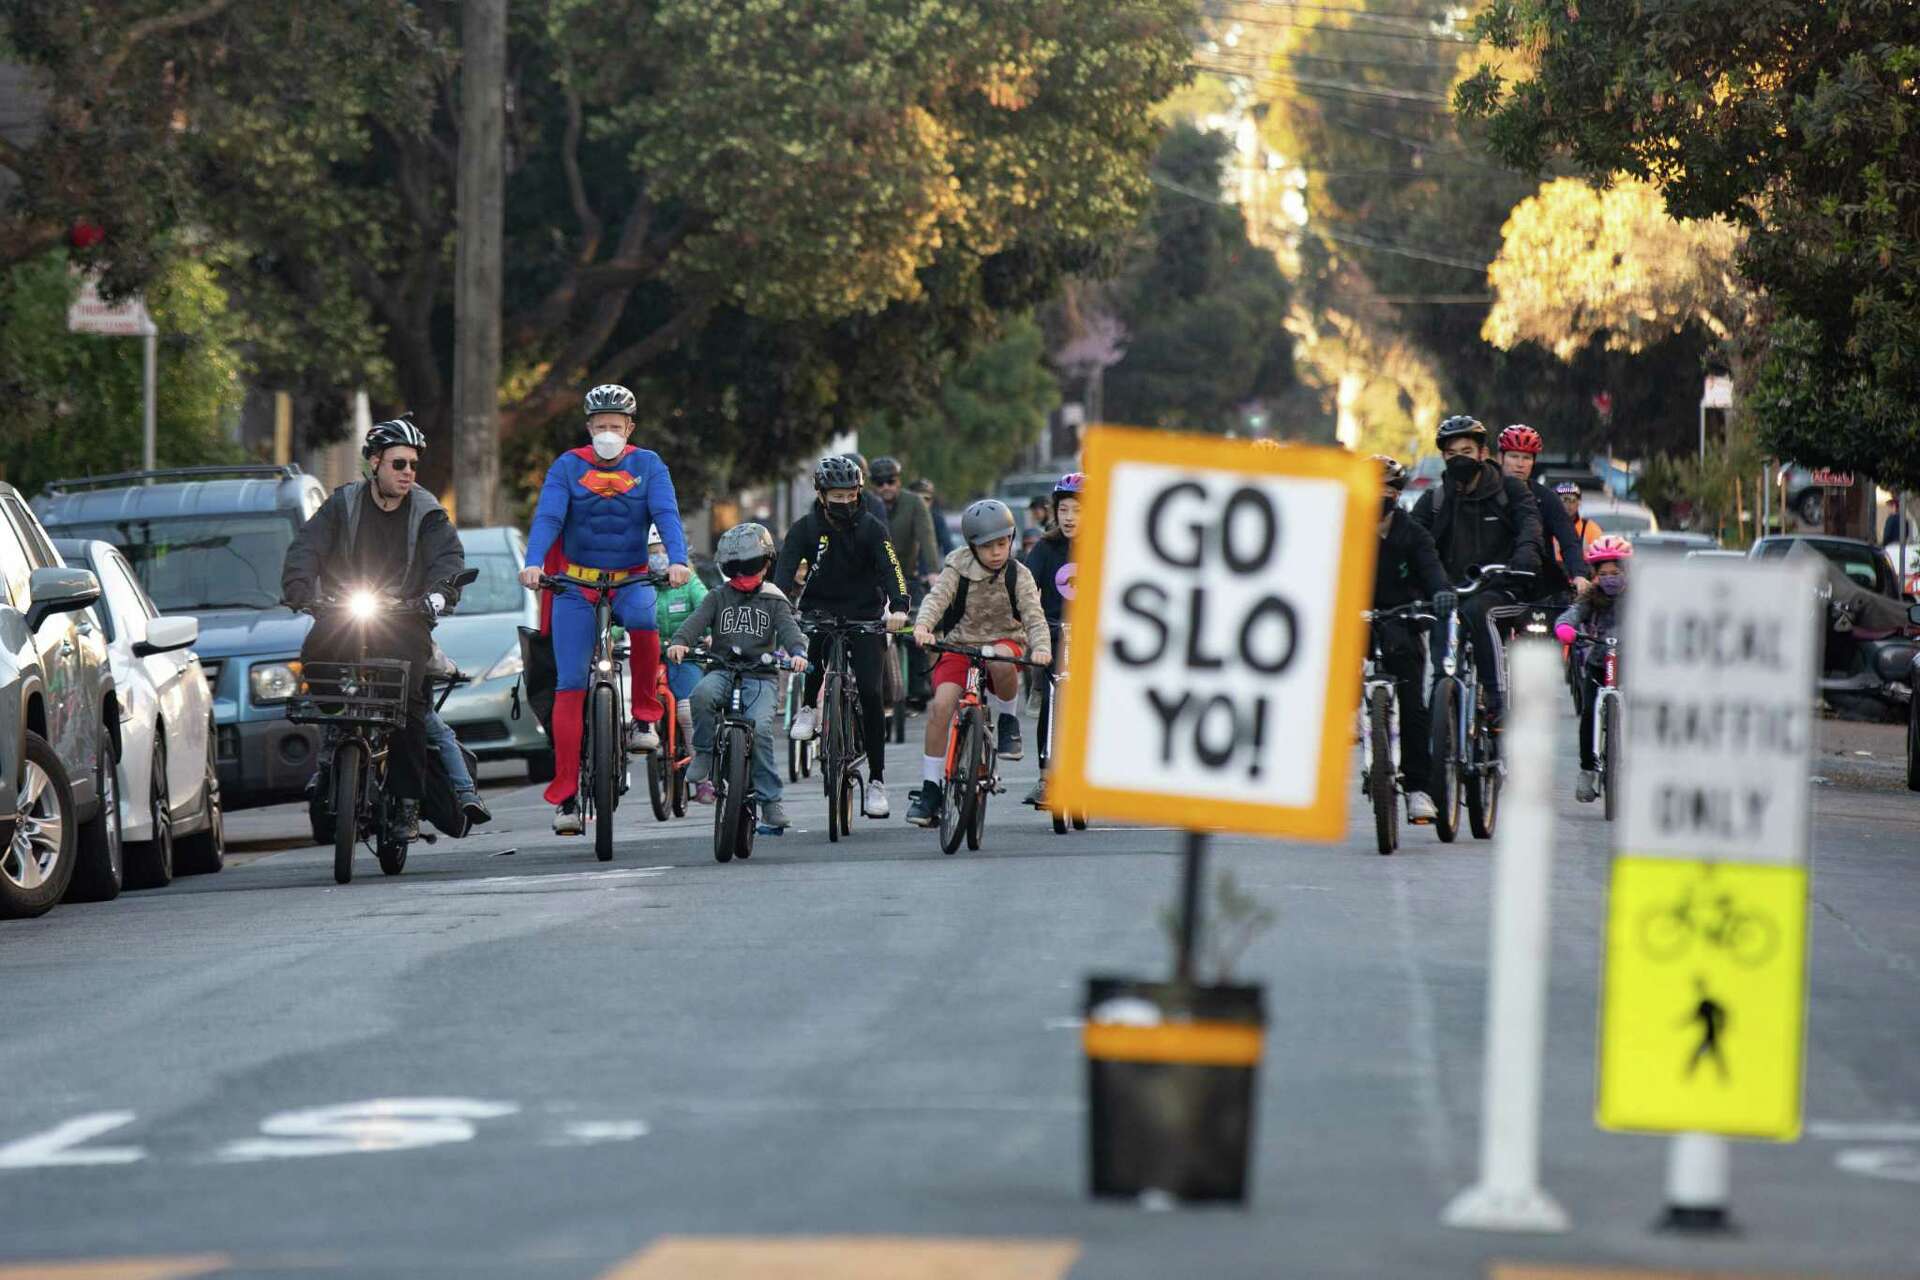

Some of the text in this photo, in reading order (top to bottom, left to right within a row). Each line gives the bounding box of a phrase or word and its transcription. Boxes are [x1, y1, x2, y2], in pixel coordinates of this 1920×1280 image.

[1146, 482, 1277, 574] GO
[720, 606, 770, 637] GAP
[1111, 582, 1298, 675] SLO
[1650, 612, 1785, 670] LOCAL
[1146, 690, 1268, 777] YO!
[1629, 699, 1801, 756] TRAFFIC
[1656, 786, 1772, 838] ONLY
